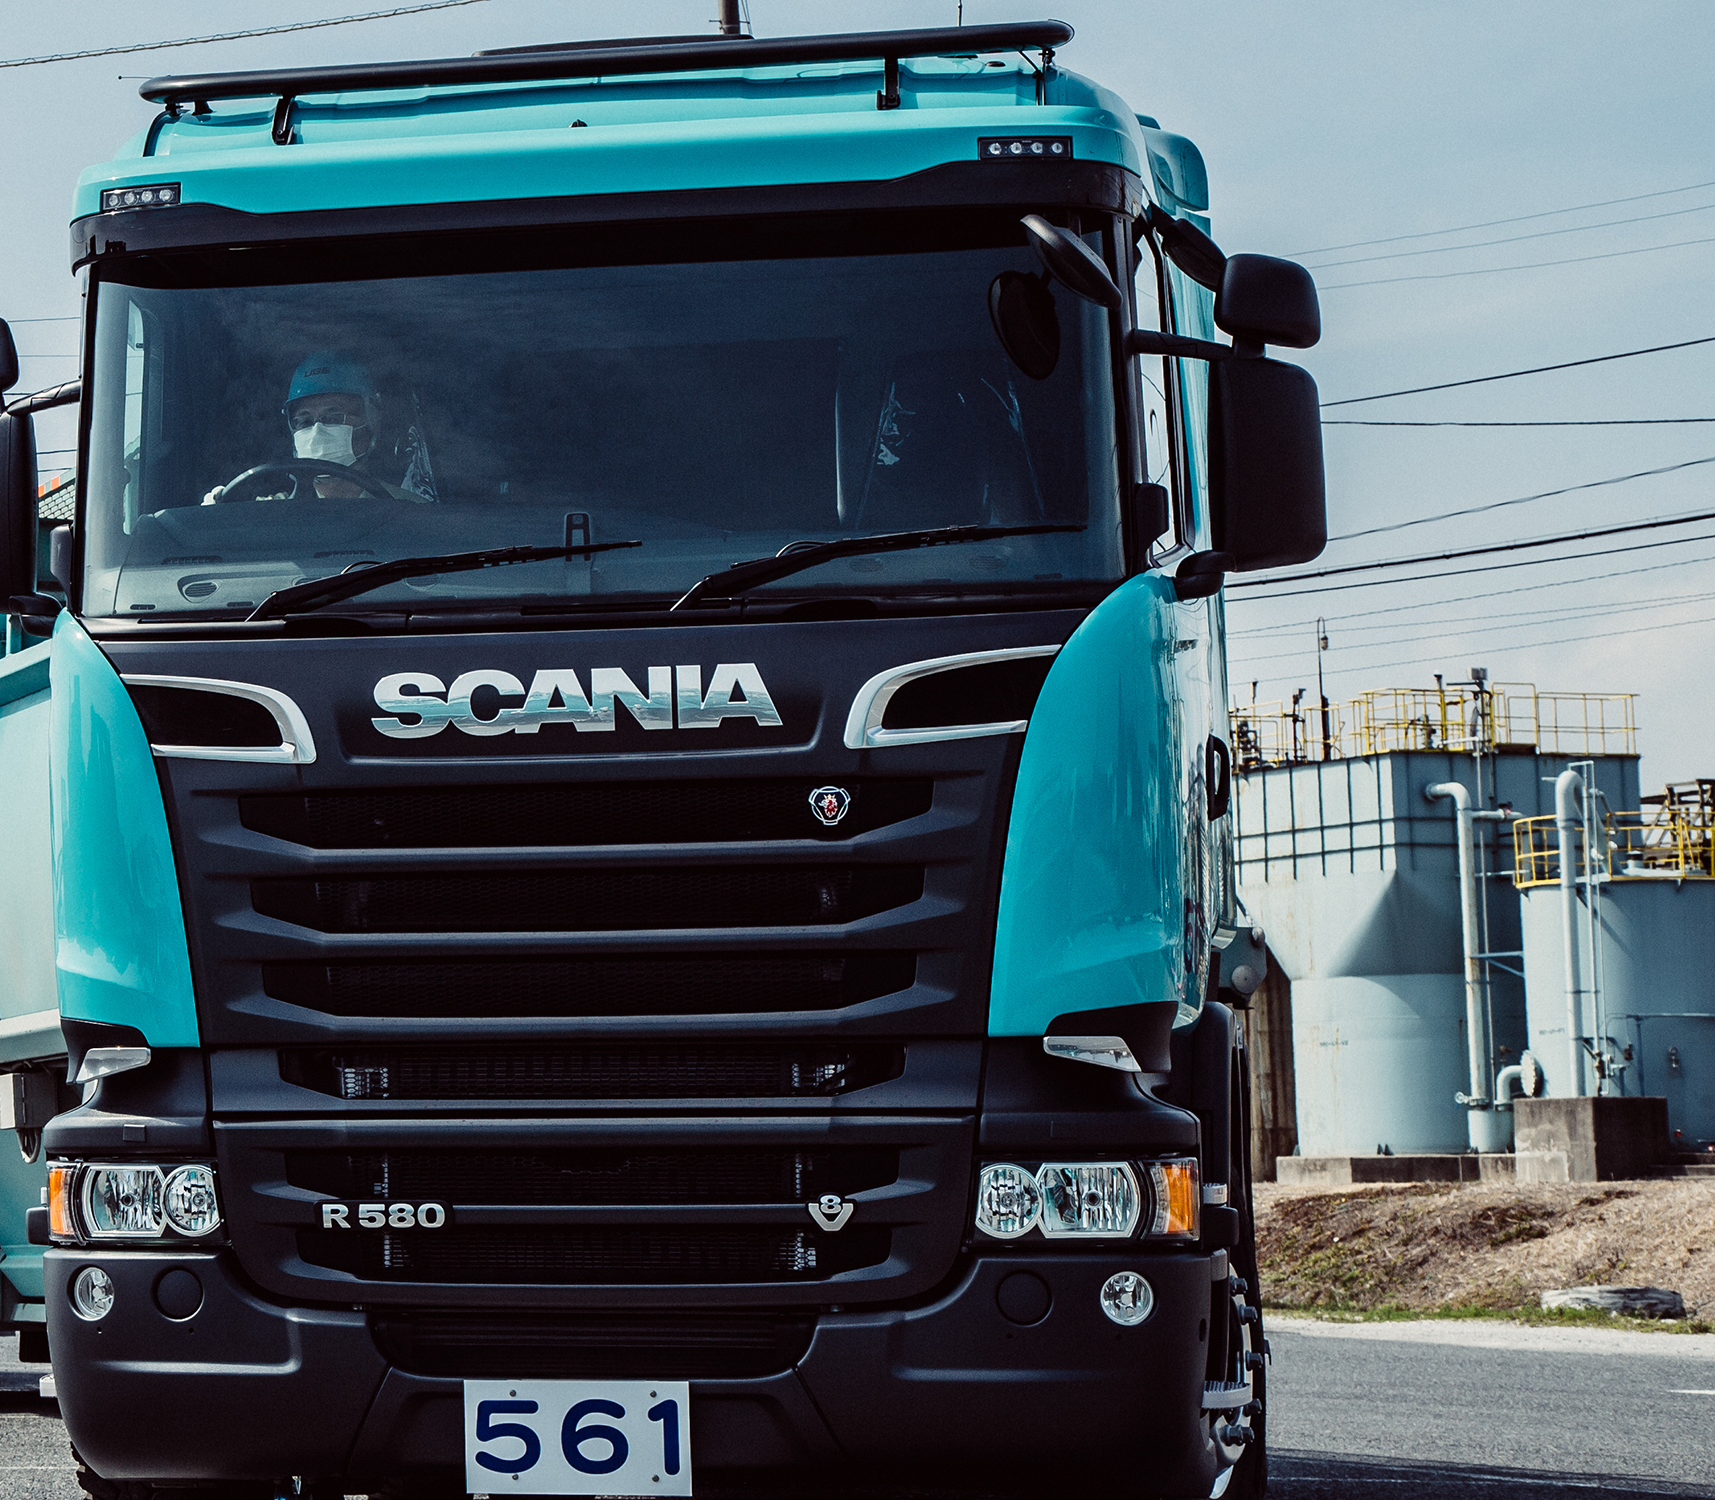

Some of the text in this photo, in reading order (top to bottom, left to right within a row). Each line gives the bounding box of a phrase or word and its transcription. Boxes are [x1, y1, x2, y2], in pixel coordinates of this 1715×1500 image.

[372, 662, 784, 739] SCANIA
[322, 1203, 445, 1229] R 580
[474, 1398, 681, 1475] 561
